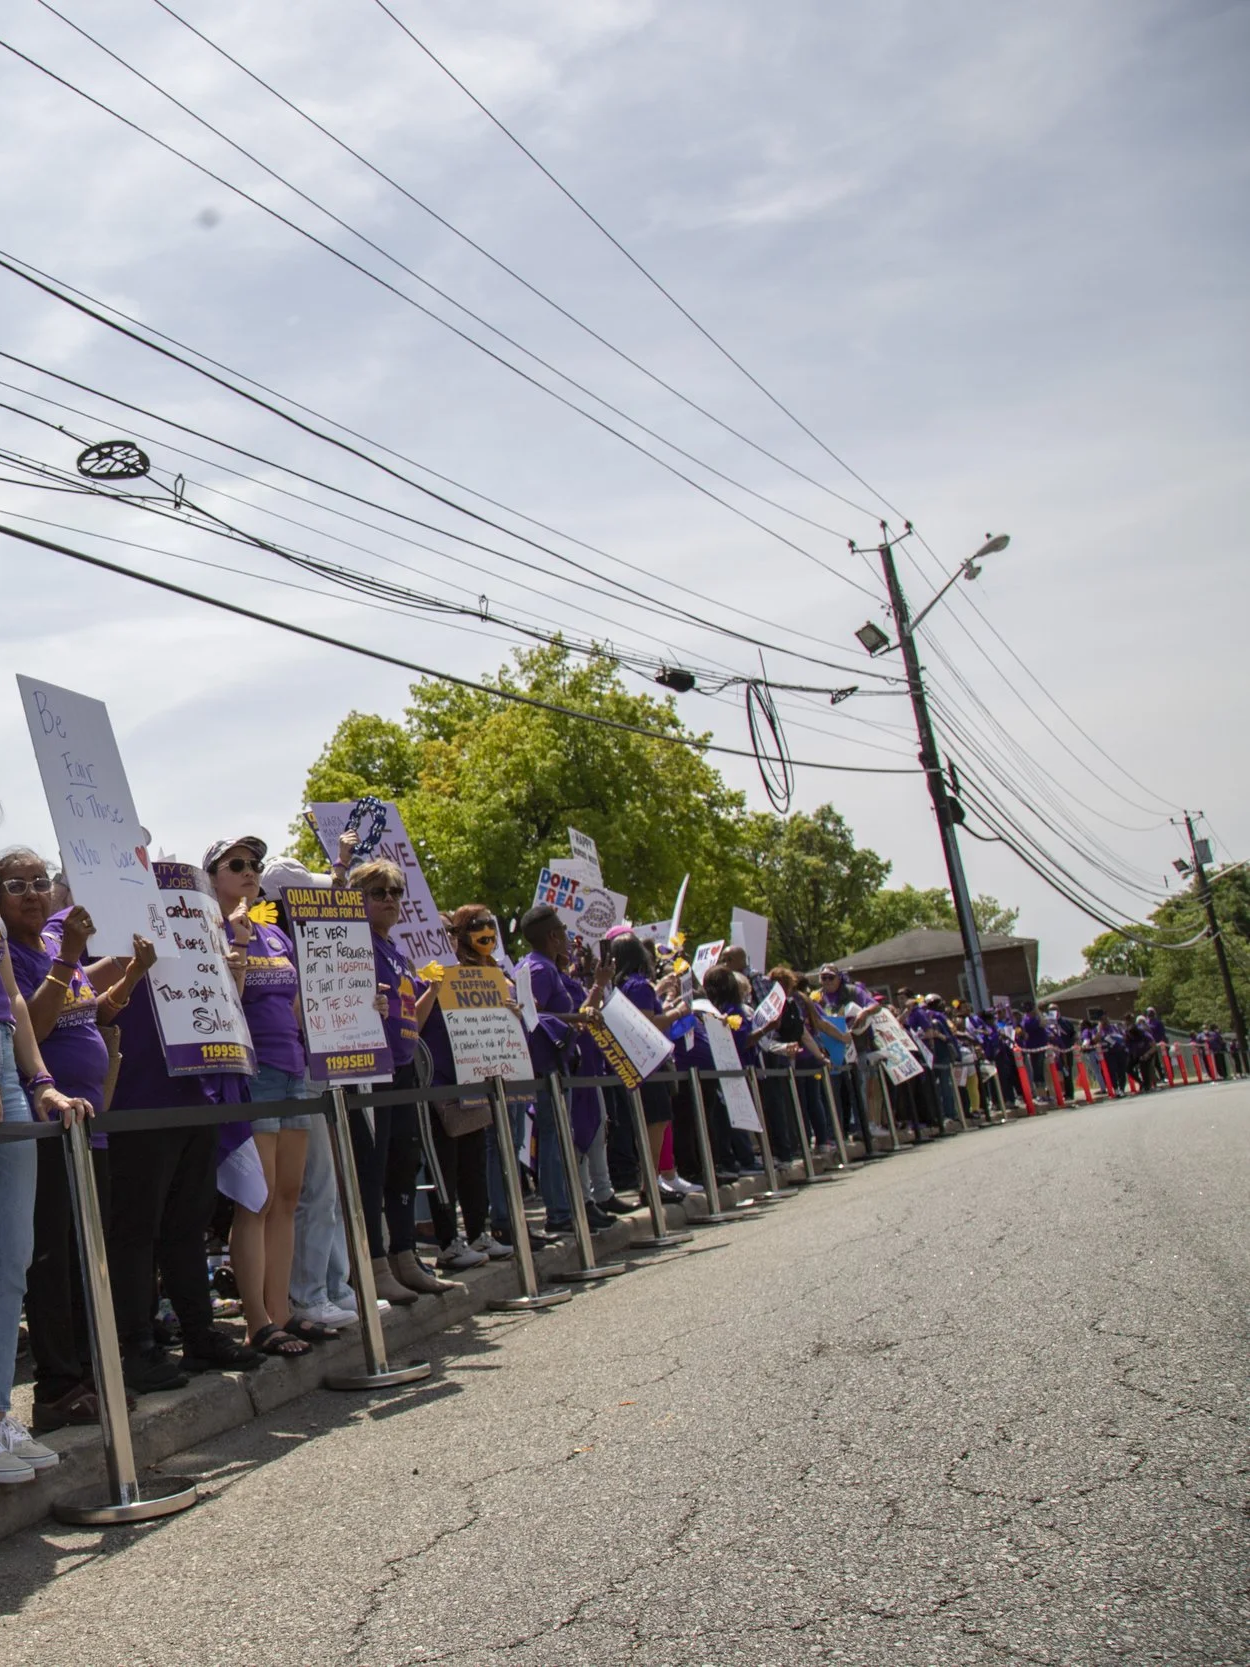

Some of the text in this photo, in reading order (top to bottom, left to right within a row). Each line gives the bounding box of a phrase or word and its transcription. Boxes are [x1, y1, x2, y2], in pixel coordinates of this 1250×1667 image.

[33, 690, 66, 738] Be
[61, 752, 94, 783] Fair
[287, 888, 364, 906] QUALITY CARE
[538, 885, 585, 913] TREAD
[298, 906, 318, 918] GOOD
[320, 907, 338, 918] JOBS
[339, 907, 353, 918] FOR
[354, 907, 367, 918] ALL
[296, 921, 348, 939] THE VERY
[307, 941, 332, 958] FIRST
[337, 961, 374, 974] HOSPITAL
[458, 969, 483, 979] SAFE
[317, 978, 334, 994] THAT
[450, 980, 497, 990] STAFFING
[455, 990, 503, 1007] NOW!
[326, 1053, 374, 1070] 1199SEIU
[603, 1048, 637, 1088] QUALITY
